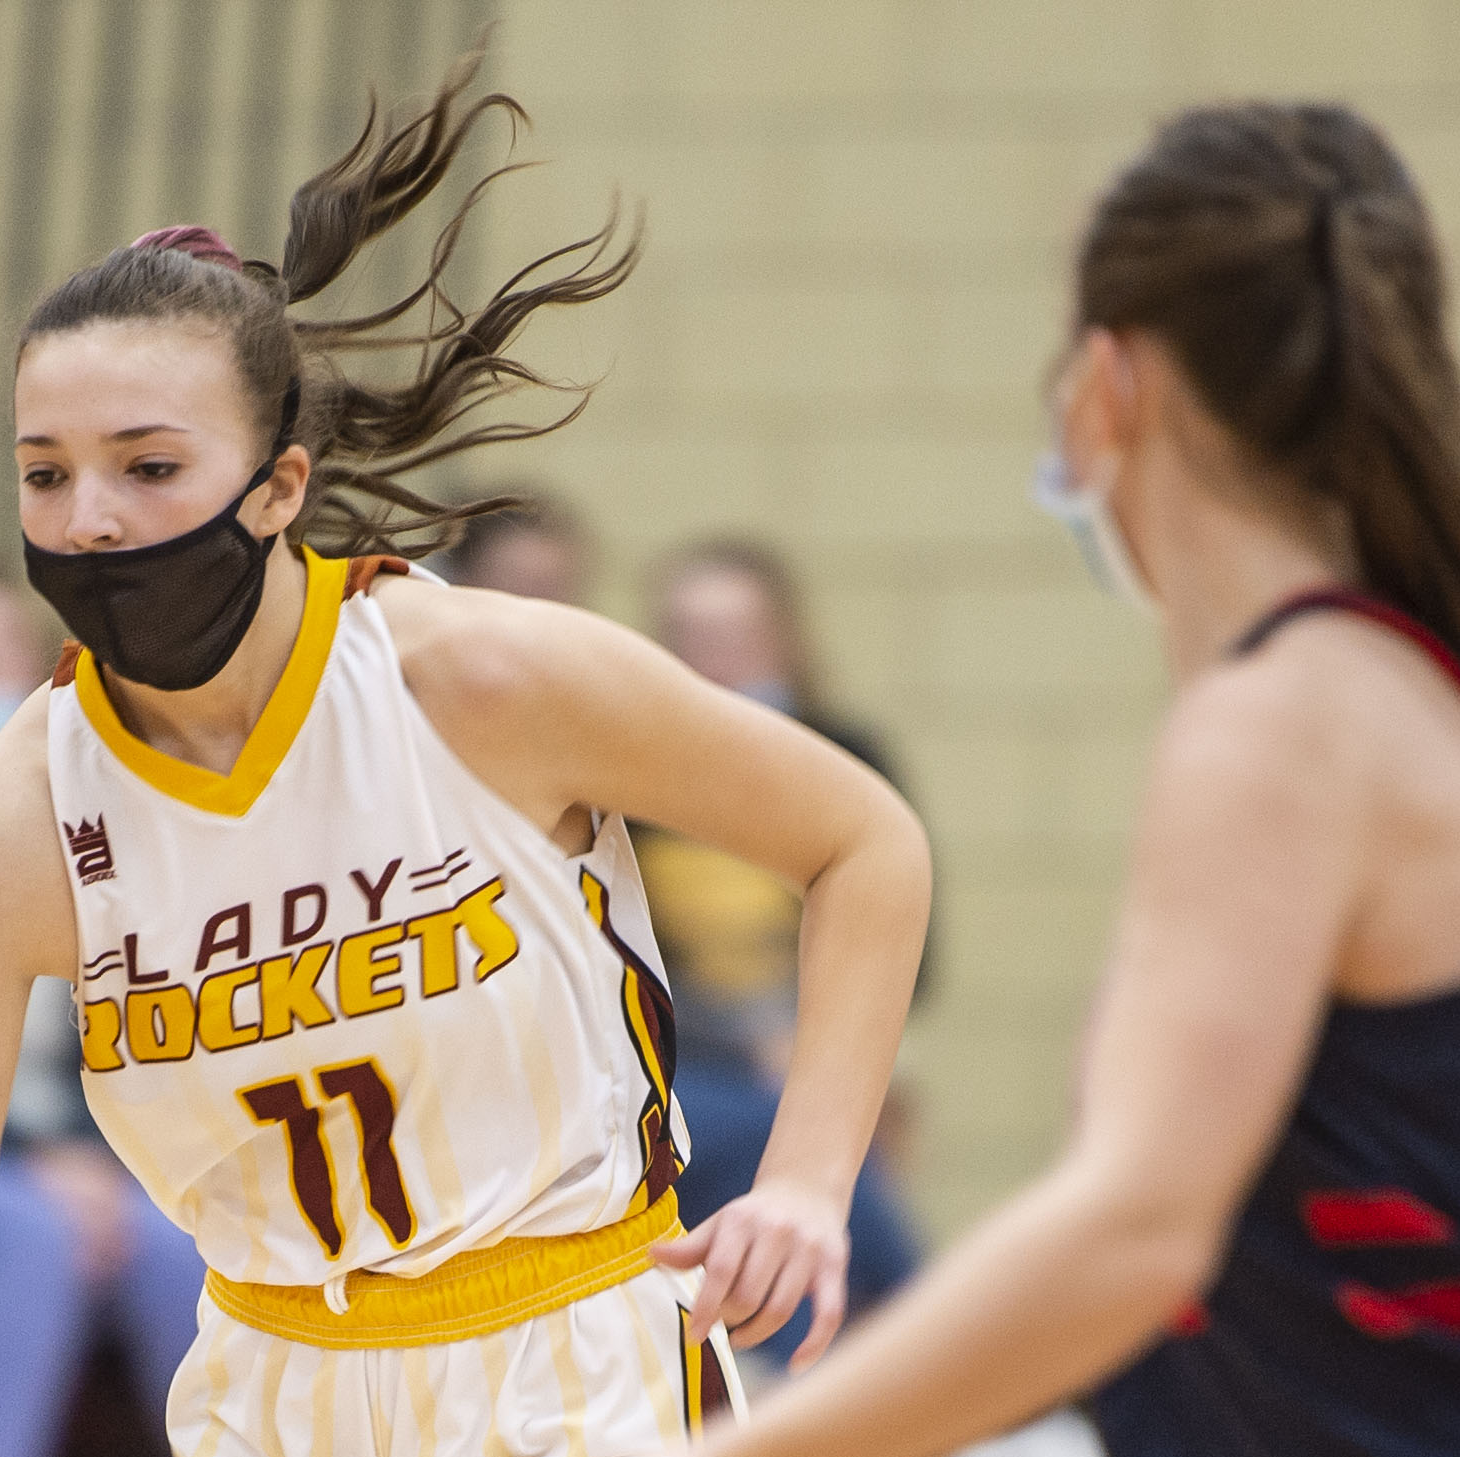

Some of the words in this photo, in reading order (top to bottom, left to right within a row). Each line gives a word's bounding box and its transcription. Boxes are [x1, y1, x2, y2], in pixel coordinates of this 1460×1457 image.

[83, 873, 520, 1073] ROCKETS
[124, 857, 404, 985] LADY
[234, 1055, 418, 1262] 11
